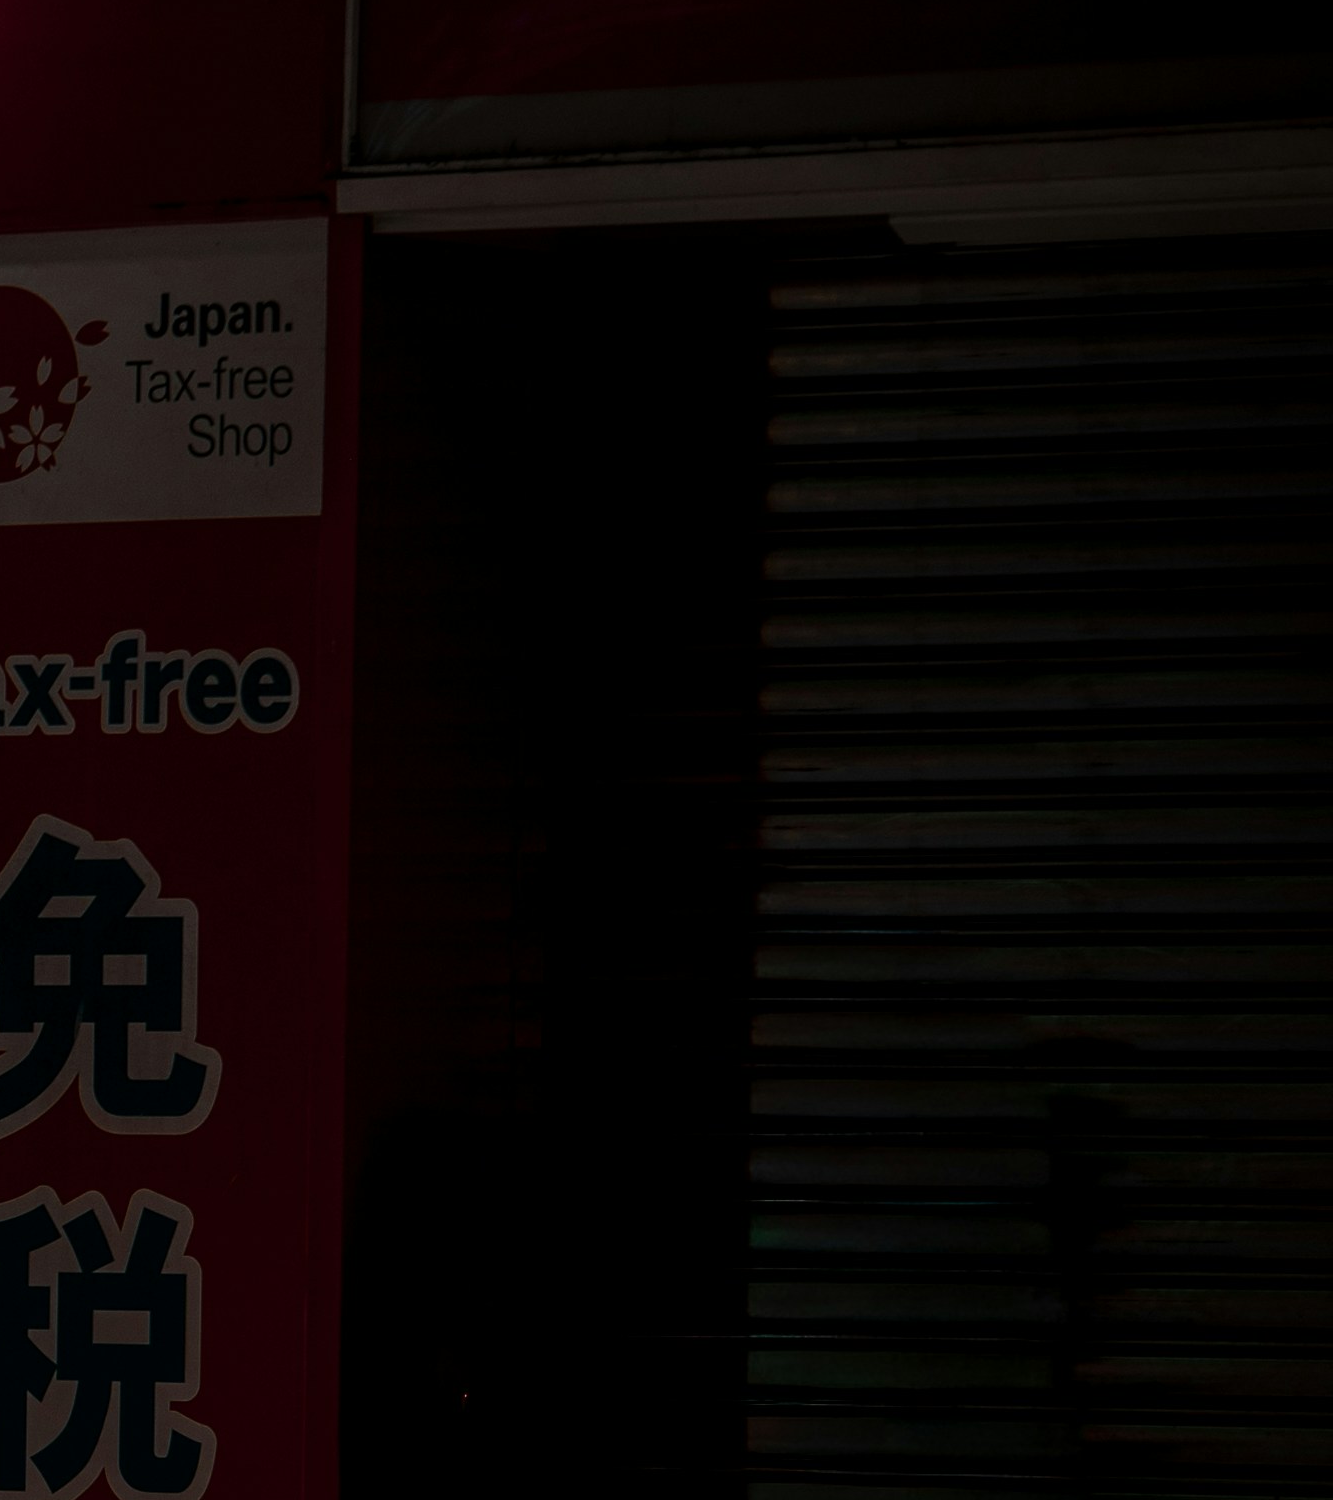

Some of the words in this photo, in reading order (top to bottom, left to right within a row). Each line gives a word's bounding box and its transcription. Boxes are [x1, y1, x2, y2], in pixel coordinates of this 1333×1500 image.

[145, 293, 294, 346] Japan.
[126, 357, 294, 404] Tax-free
[187, 414, 293, 466] Shop
